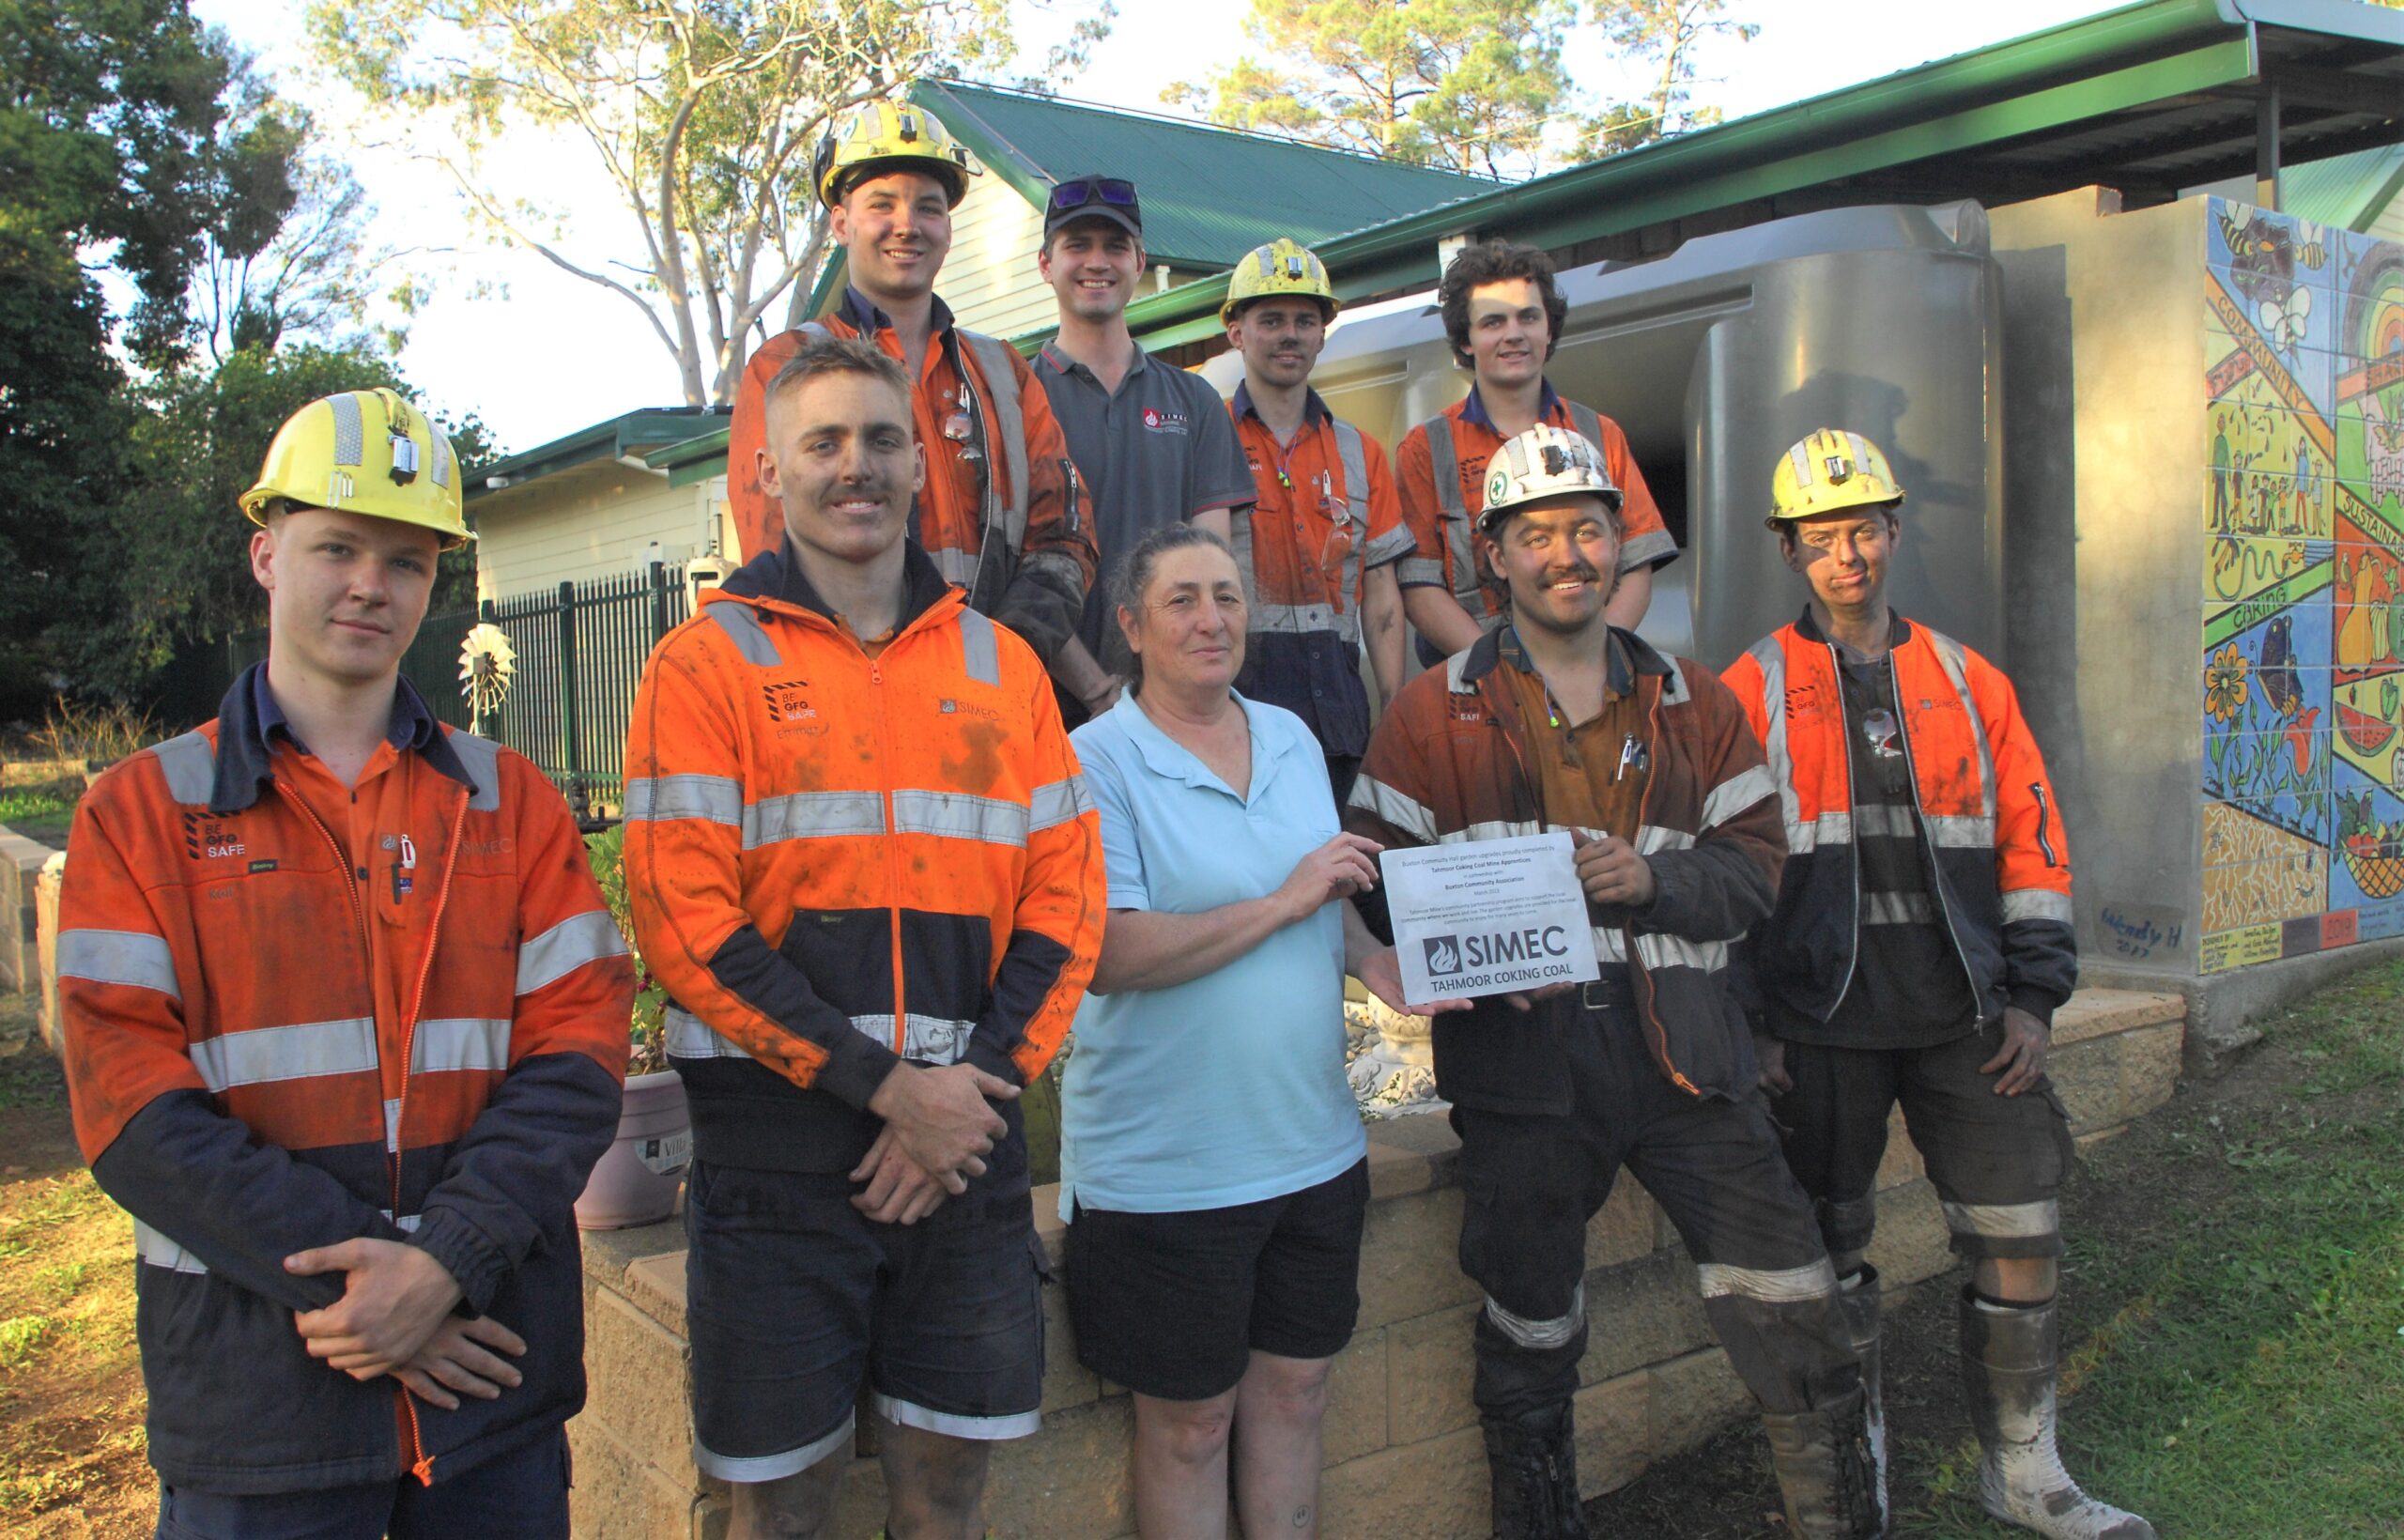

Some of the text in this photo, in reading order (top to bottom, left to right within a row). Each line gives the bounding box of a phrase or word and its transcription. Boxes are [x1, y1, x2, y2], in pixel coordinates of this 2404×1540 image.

[782, 692, 795, 702] BE
[784, 701, 809, 711] GFG
[959, 701, 1000, 721] SIMEC
[787, 709, 816, 721] SAFE
[205, 824, 222, 835] BE
[207, 833, 238, 845] GFG
[208, 844, 245, 858] SAFE
[1501, 856, 1531, 865] Apprentices
[1464, 879, 1494, 887] Community
[2167, 923, 2181, 947] H
[1465, 926, 1568, 967] SIMEC
[1431, 963, 1573, 993] TAHMOOR COKING COAL
